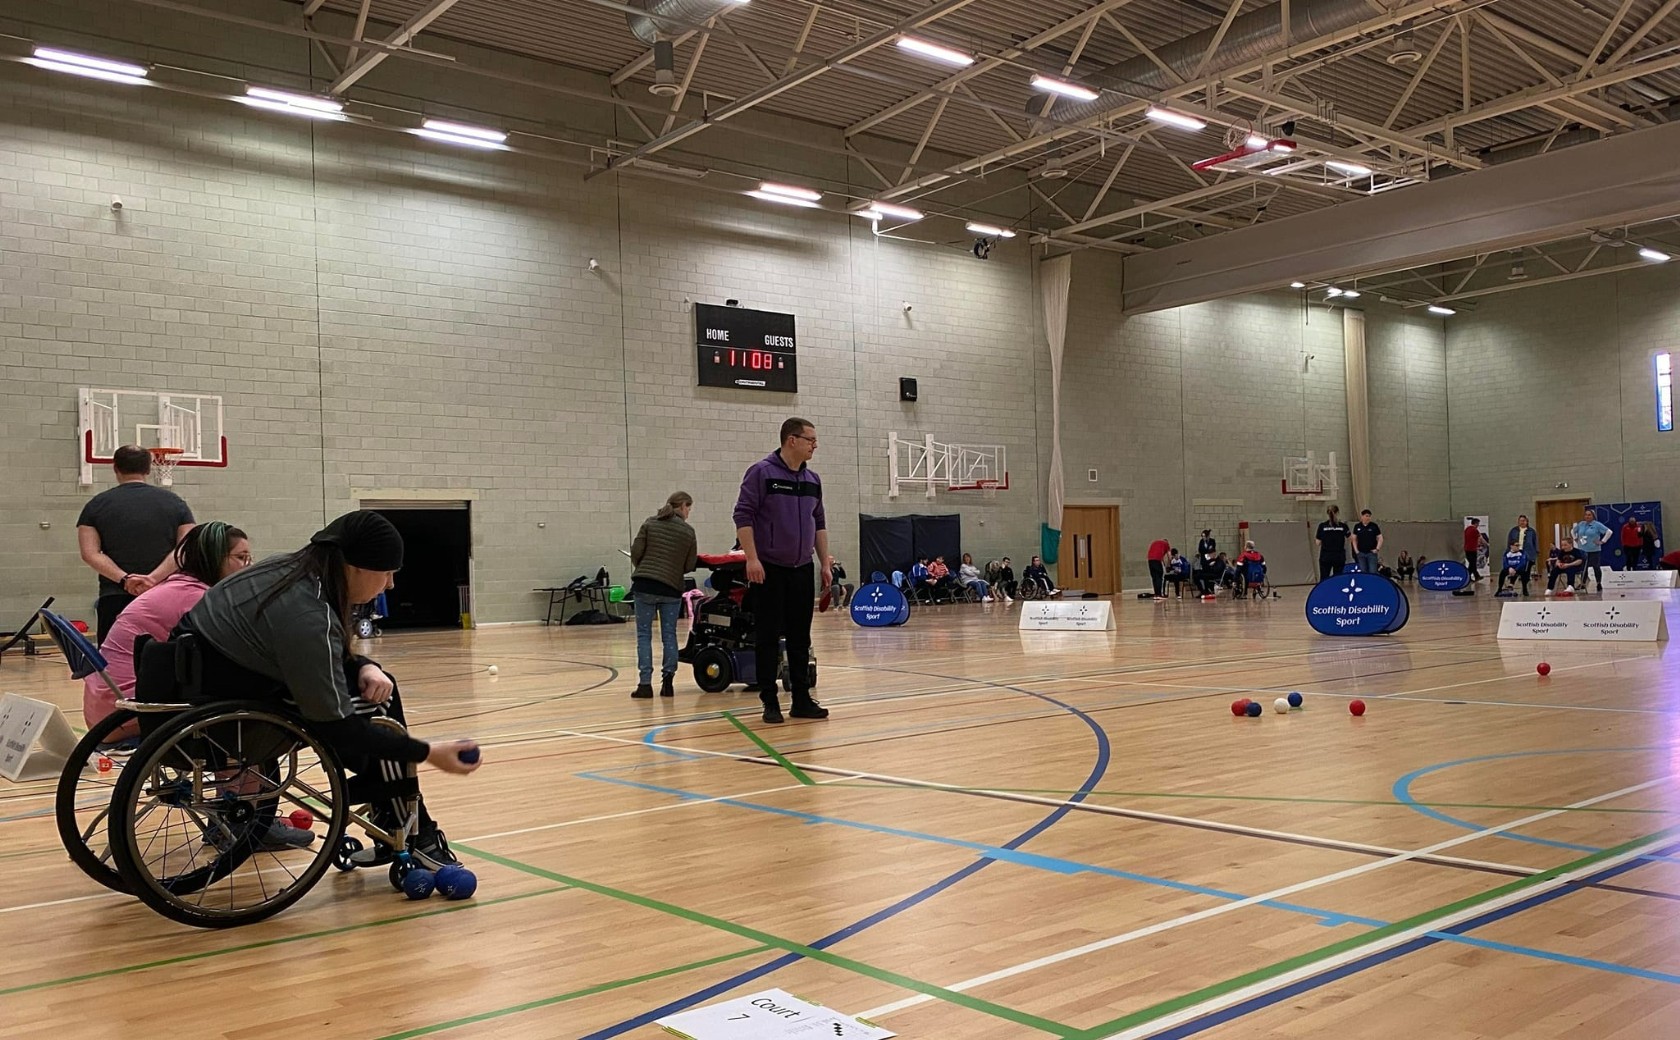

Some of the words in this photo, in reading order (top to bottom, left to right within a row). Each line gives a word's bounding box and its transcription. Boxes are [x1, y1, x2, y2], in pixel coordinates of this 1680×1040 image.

[706, 328, 729, 341] HOME
[764, 335, 793, 347] GUESTS
[873, 605, 896, 613] Disability
[1312, 606, 1346, 615] Scottish
[1348, 605, 1389, 615] Disability
[1336, 617, 1360, 627] Sport
[751, 998, 801, 1018] Court
[727, 1013, 751, 1021] 7
